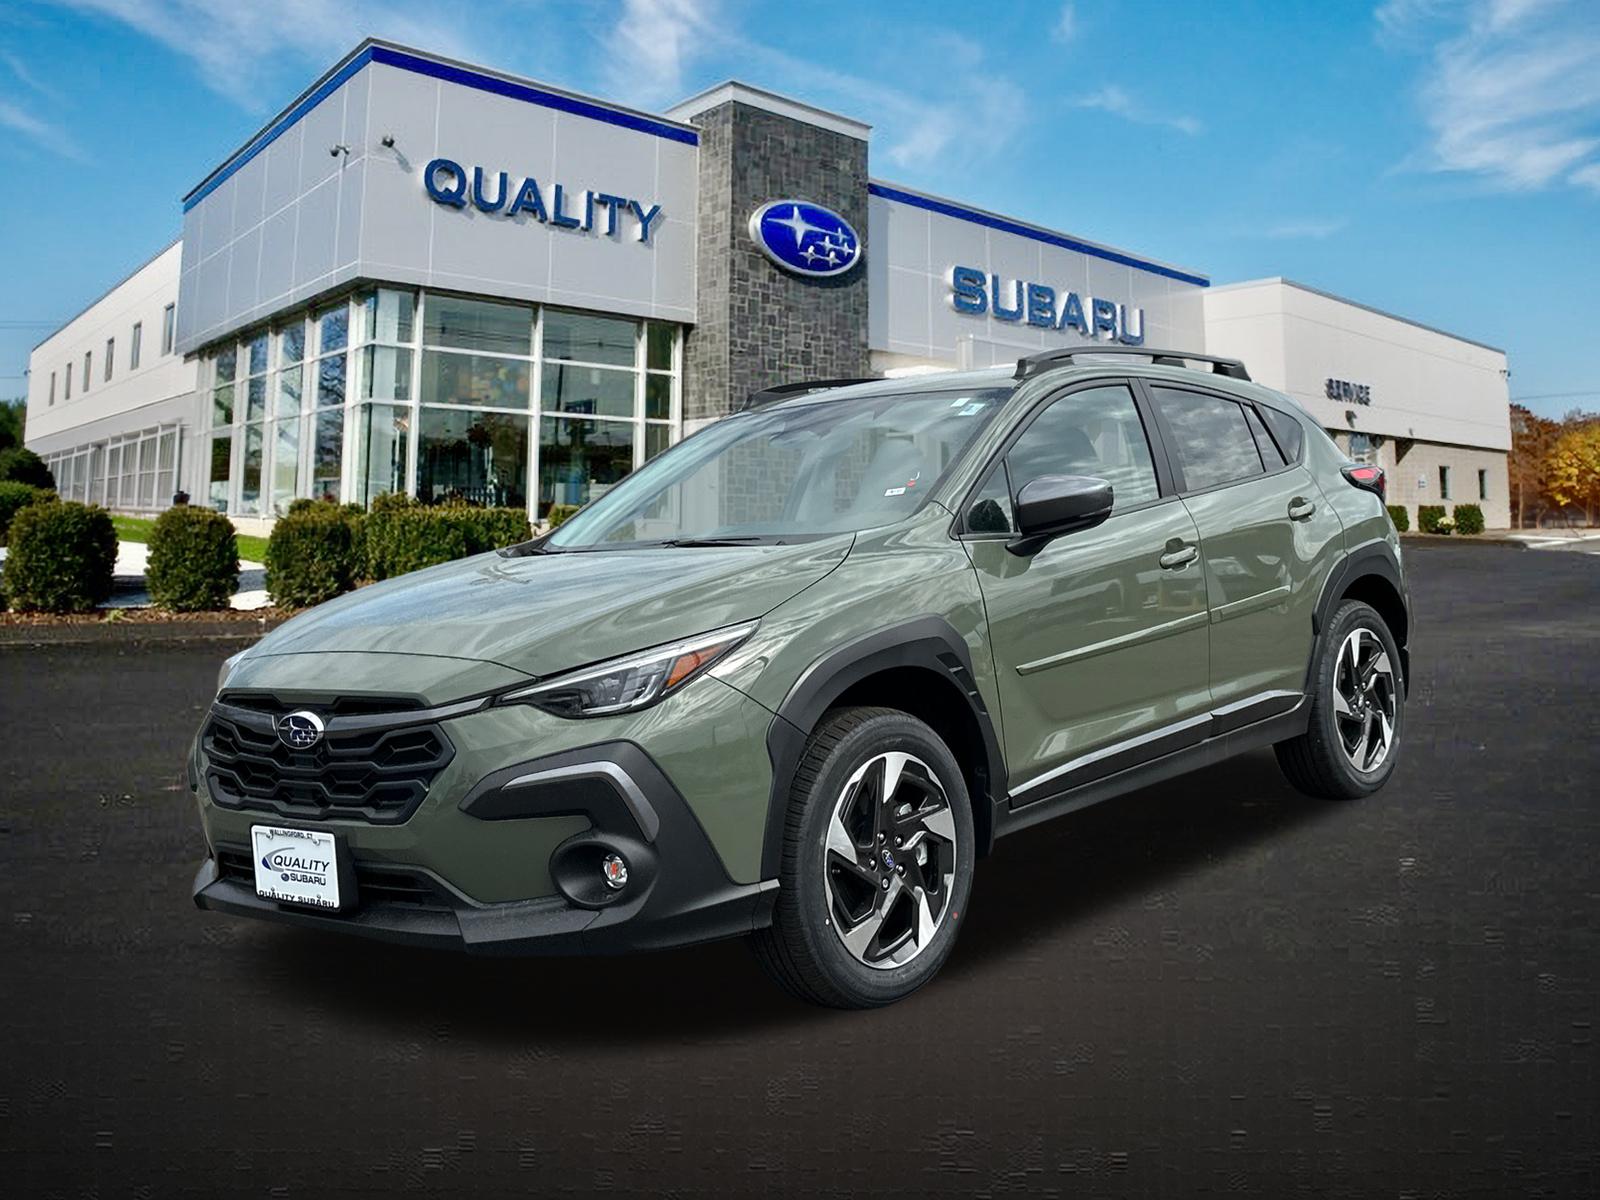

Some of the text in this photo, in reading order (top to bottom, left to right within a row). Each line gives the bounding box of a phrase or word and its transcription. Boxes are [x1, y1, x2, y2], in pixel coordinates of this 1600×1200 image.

[424, 158, 662, 243] QUALITY
[952, 265, 1144, 346] SUBARU
[274, 855, 330, 872] QUALITY
[290, 872, 326, 886] SUBARU
[258, 889, 335, 908] QUALITY SUBARU
